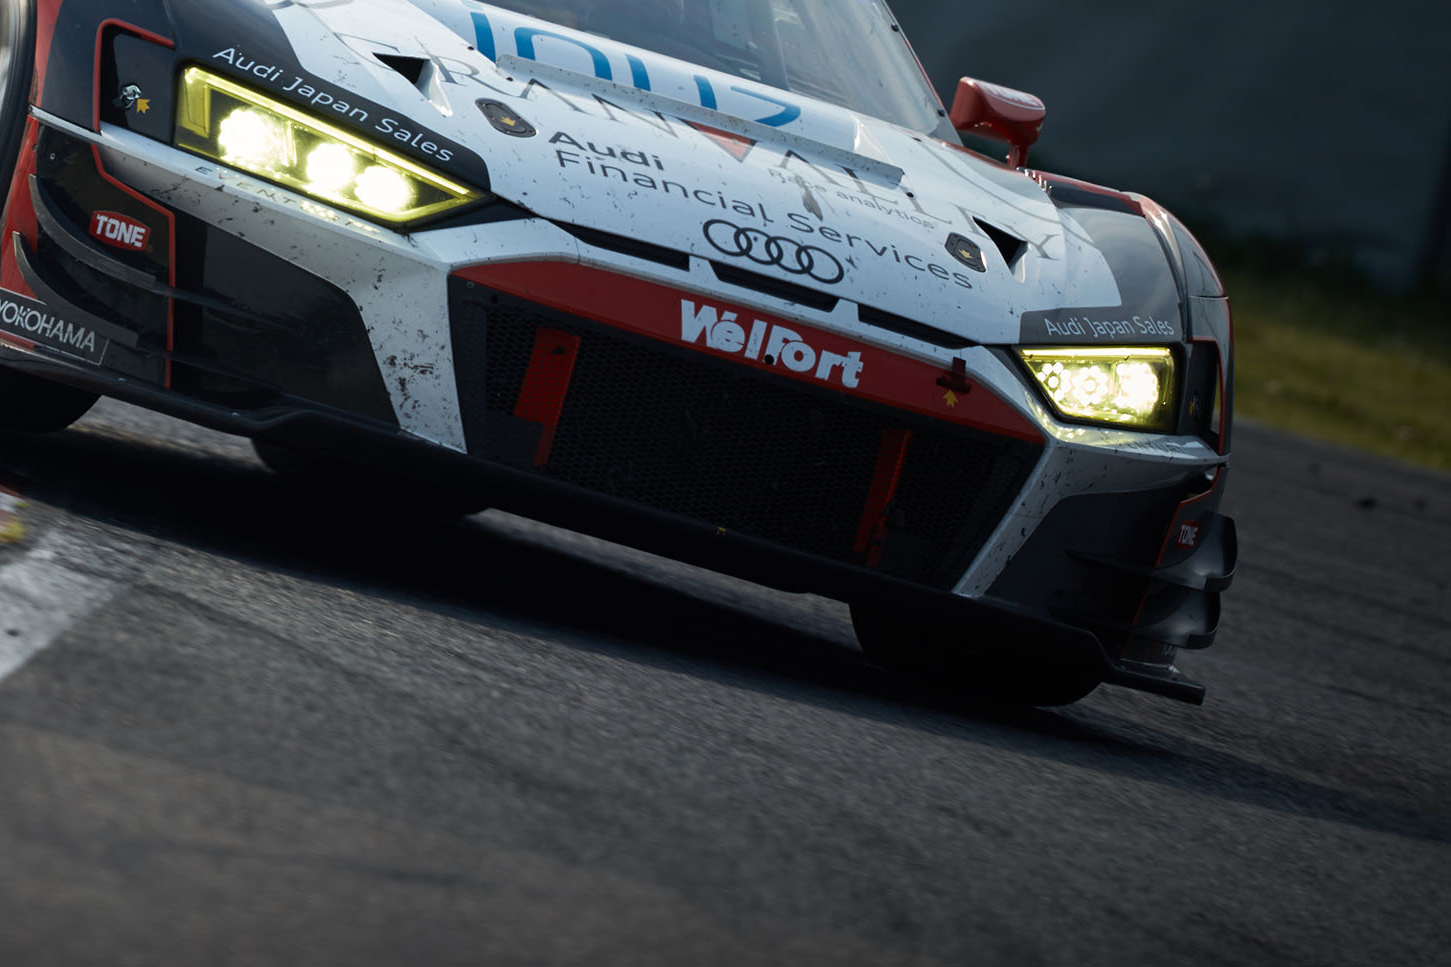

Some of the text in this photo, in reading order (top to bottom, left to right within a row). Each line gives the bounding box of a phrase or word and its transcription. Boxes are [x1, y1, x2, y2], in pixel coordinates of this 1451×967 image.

[213, 47, 455, 163] Audi Japan Sales
[548, 131, 665, 171] Audi
[96, 213, 146, 248] TONE
[557, 149, 973, 290] Financial Services
[1044, 316, 1174, 340] Audi Japan Sales
